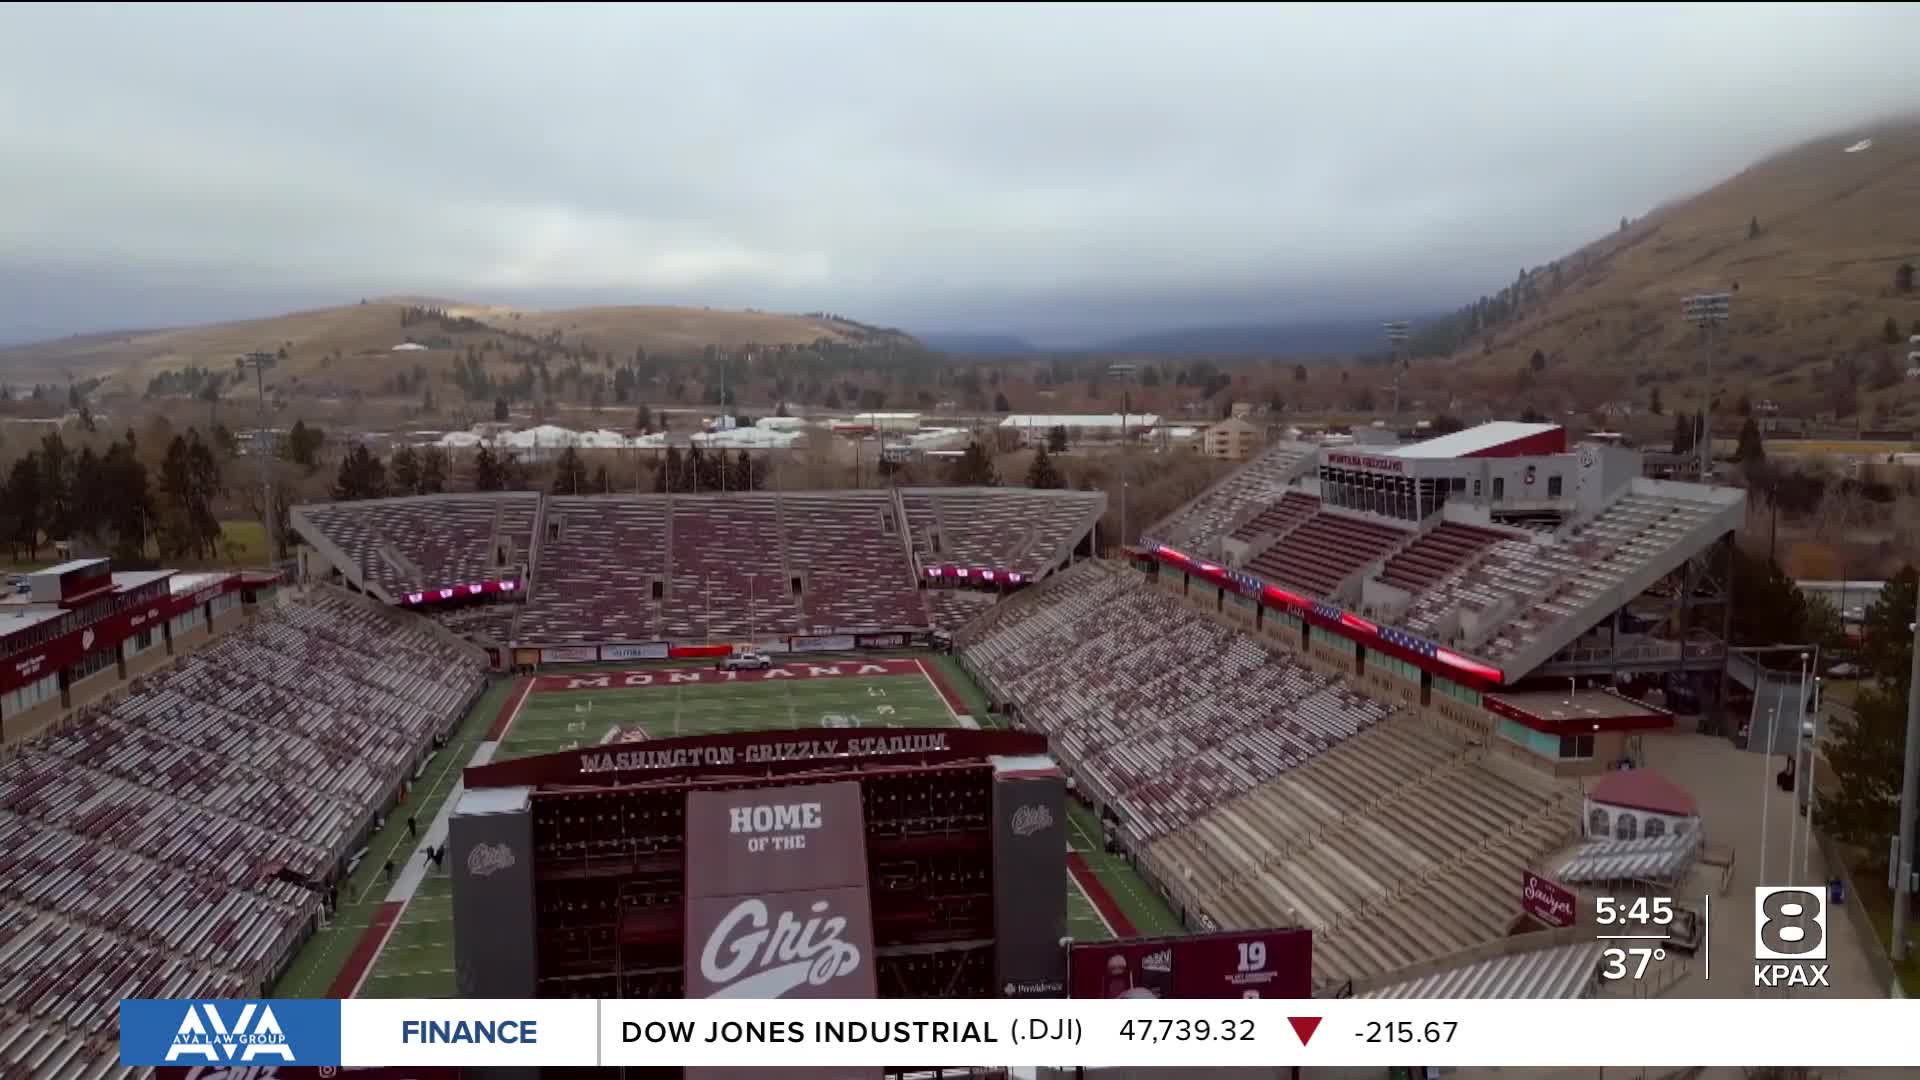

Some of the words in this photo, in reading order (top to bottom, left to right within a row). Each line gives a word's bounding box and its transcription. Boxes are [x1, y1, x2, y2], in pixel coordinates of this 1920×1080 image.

[567, 663, 889, 689] MONTANA
[579, 740, 838, 772] WASHINGTON-GRIZZLY
[847, 733, 947, 758] STADIUM
[729, 803, 822, 832] HOME
[748, 837, 769, 852] OF
[772, 835, 806, 850] THE
[1525, 877, 1571, 915] Sawyer
[700, 899, 861, 988] Griz
[1237, 941, 1266, 971] 19
